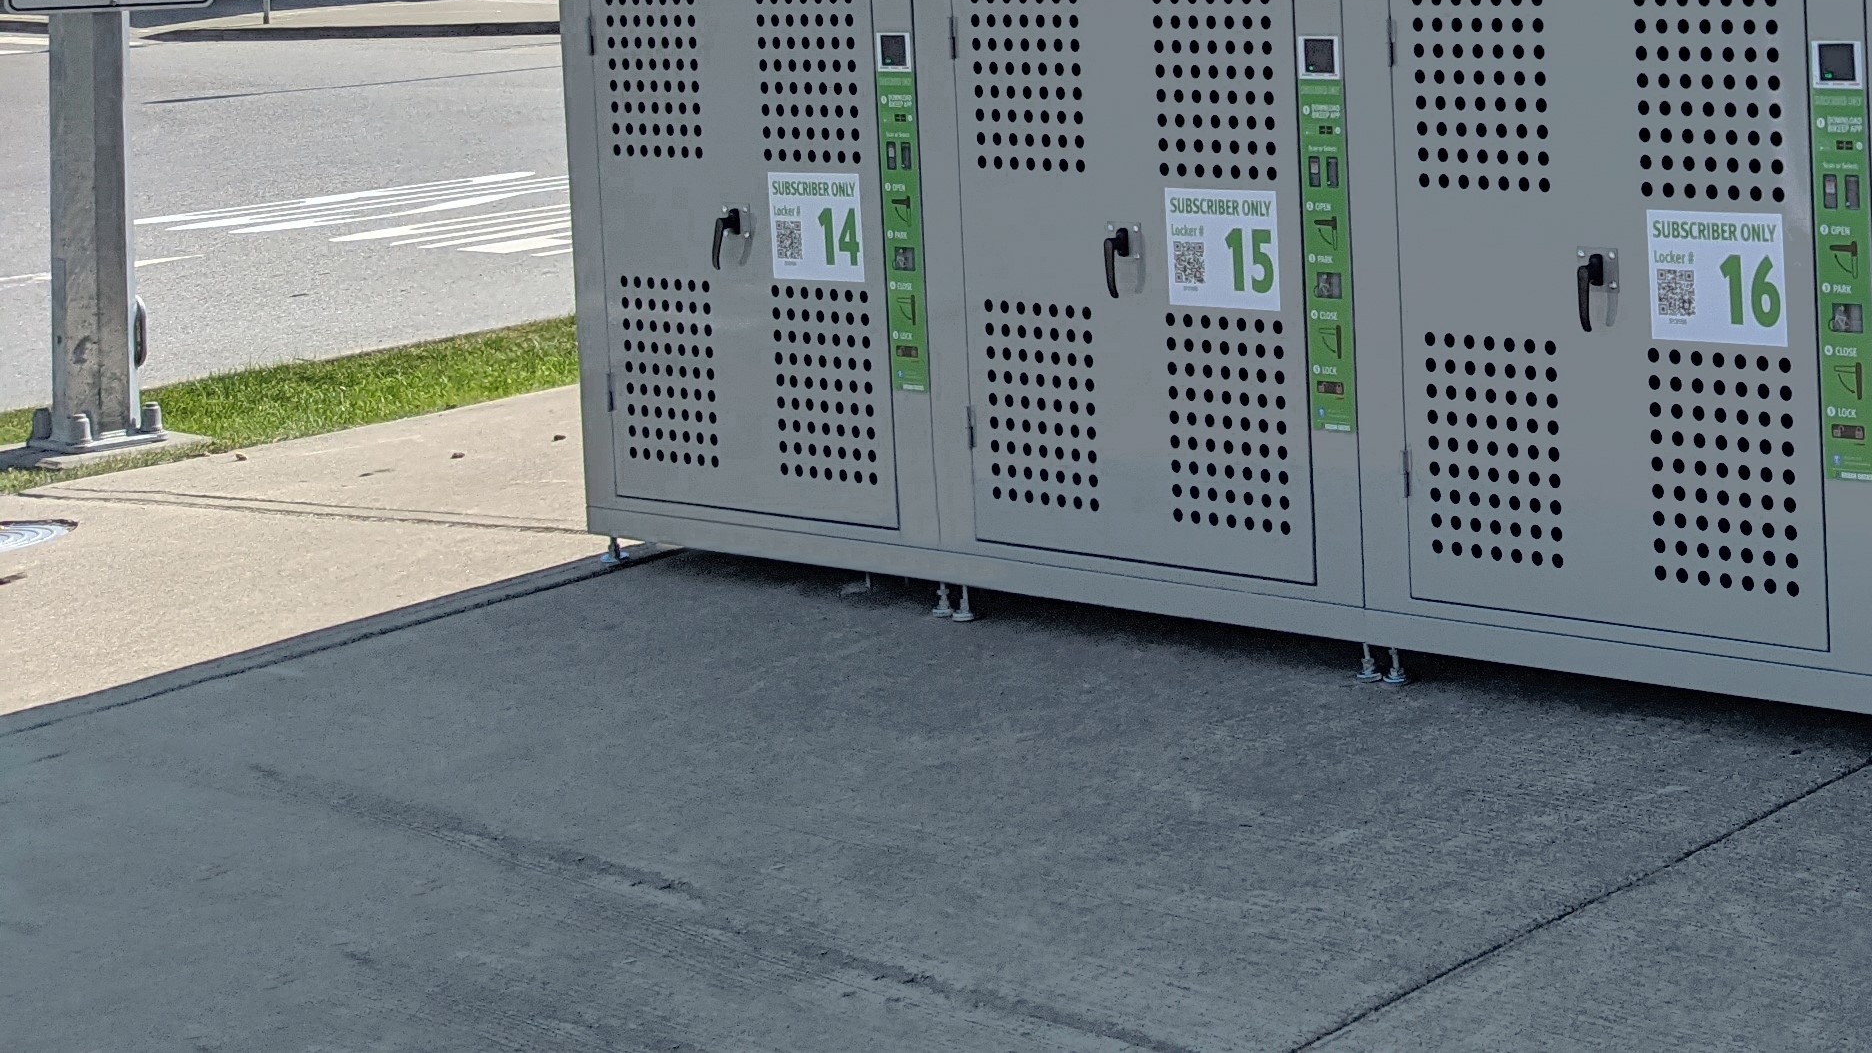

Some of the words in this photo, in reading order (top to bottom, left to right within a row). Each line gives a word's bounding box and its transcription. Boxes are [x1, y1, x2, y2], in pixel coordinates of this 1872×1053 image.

[772, 180, 830, 197] SUBSCRIBER
[831, 181, 856, 198] ONLY
[773, 205, 795, 217] Locker
[1169, 197, 1240, 216] SUBSCRIBER
[1241, 199, 1272, 217] ONLY
[1315, 202, 1332, 211] OPEN
[1171, 223, 1198, 236] Locker
[1652, 220, 1738, 242] SUBSCRIBER
[1740, 223, 1777, 243] ONLY
[1830, 225, 1851, 236] OPEN
[817, 208, 860, 266] 14
[1224, 227, 1275, 294] 15
[1653, 249, 1685, 264] Locker
[1688, 251, 1695, 265] #
[1719, 254, 1781, 328] 16
[1832, 284, 1852, 294] PARK
[1319, 311, 1338, 321] CLOSE
[1835, 346, 1857, 357] CLOSE
[1321, 367, 1337, 375] LOCK
[1837, 408, 1857, 418] LOCK
